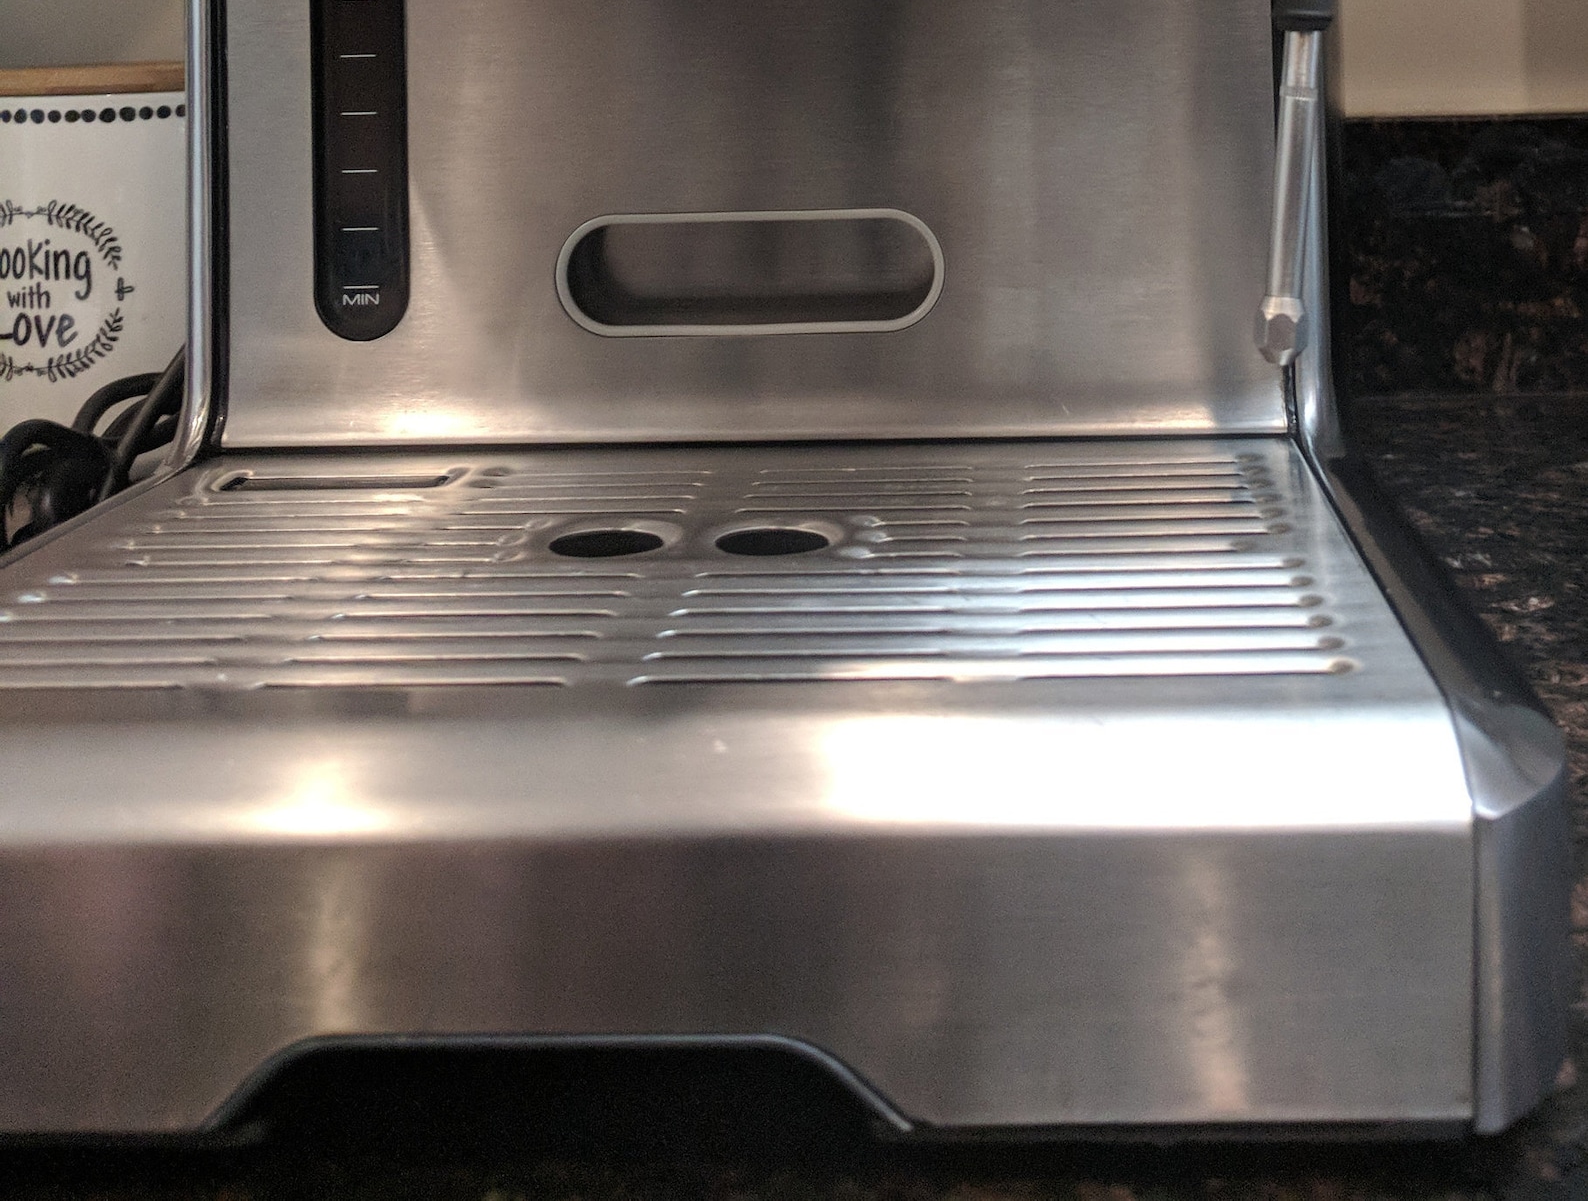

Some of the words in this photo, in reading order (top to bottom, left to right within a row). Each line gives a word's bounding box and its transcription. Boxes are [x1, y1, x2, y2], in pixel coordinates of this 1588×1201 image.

[0, 239, 92, 300] ooking
[7, 281, 51, 310] with
[342, 293, 380, 306] MIN
